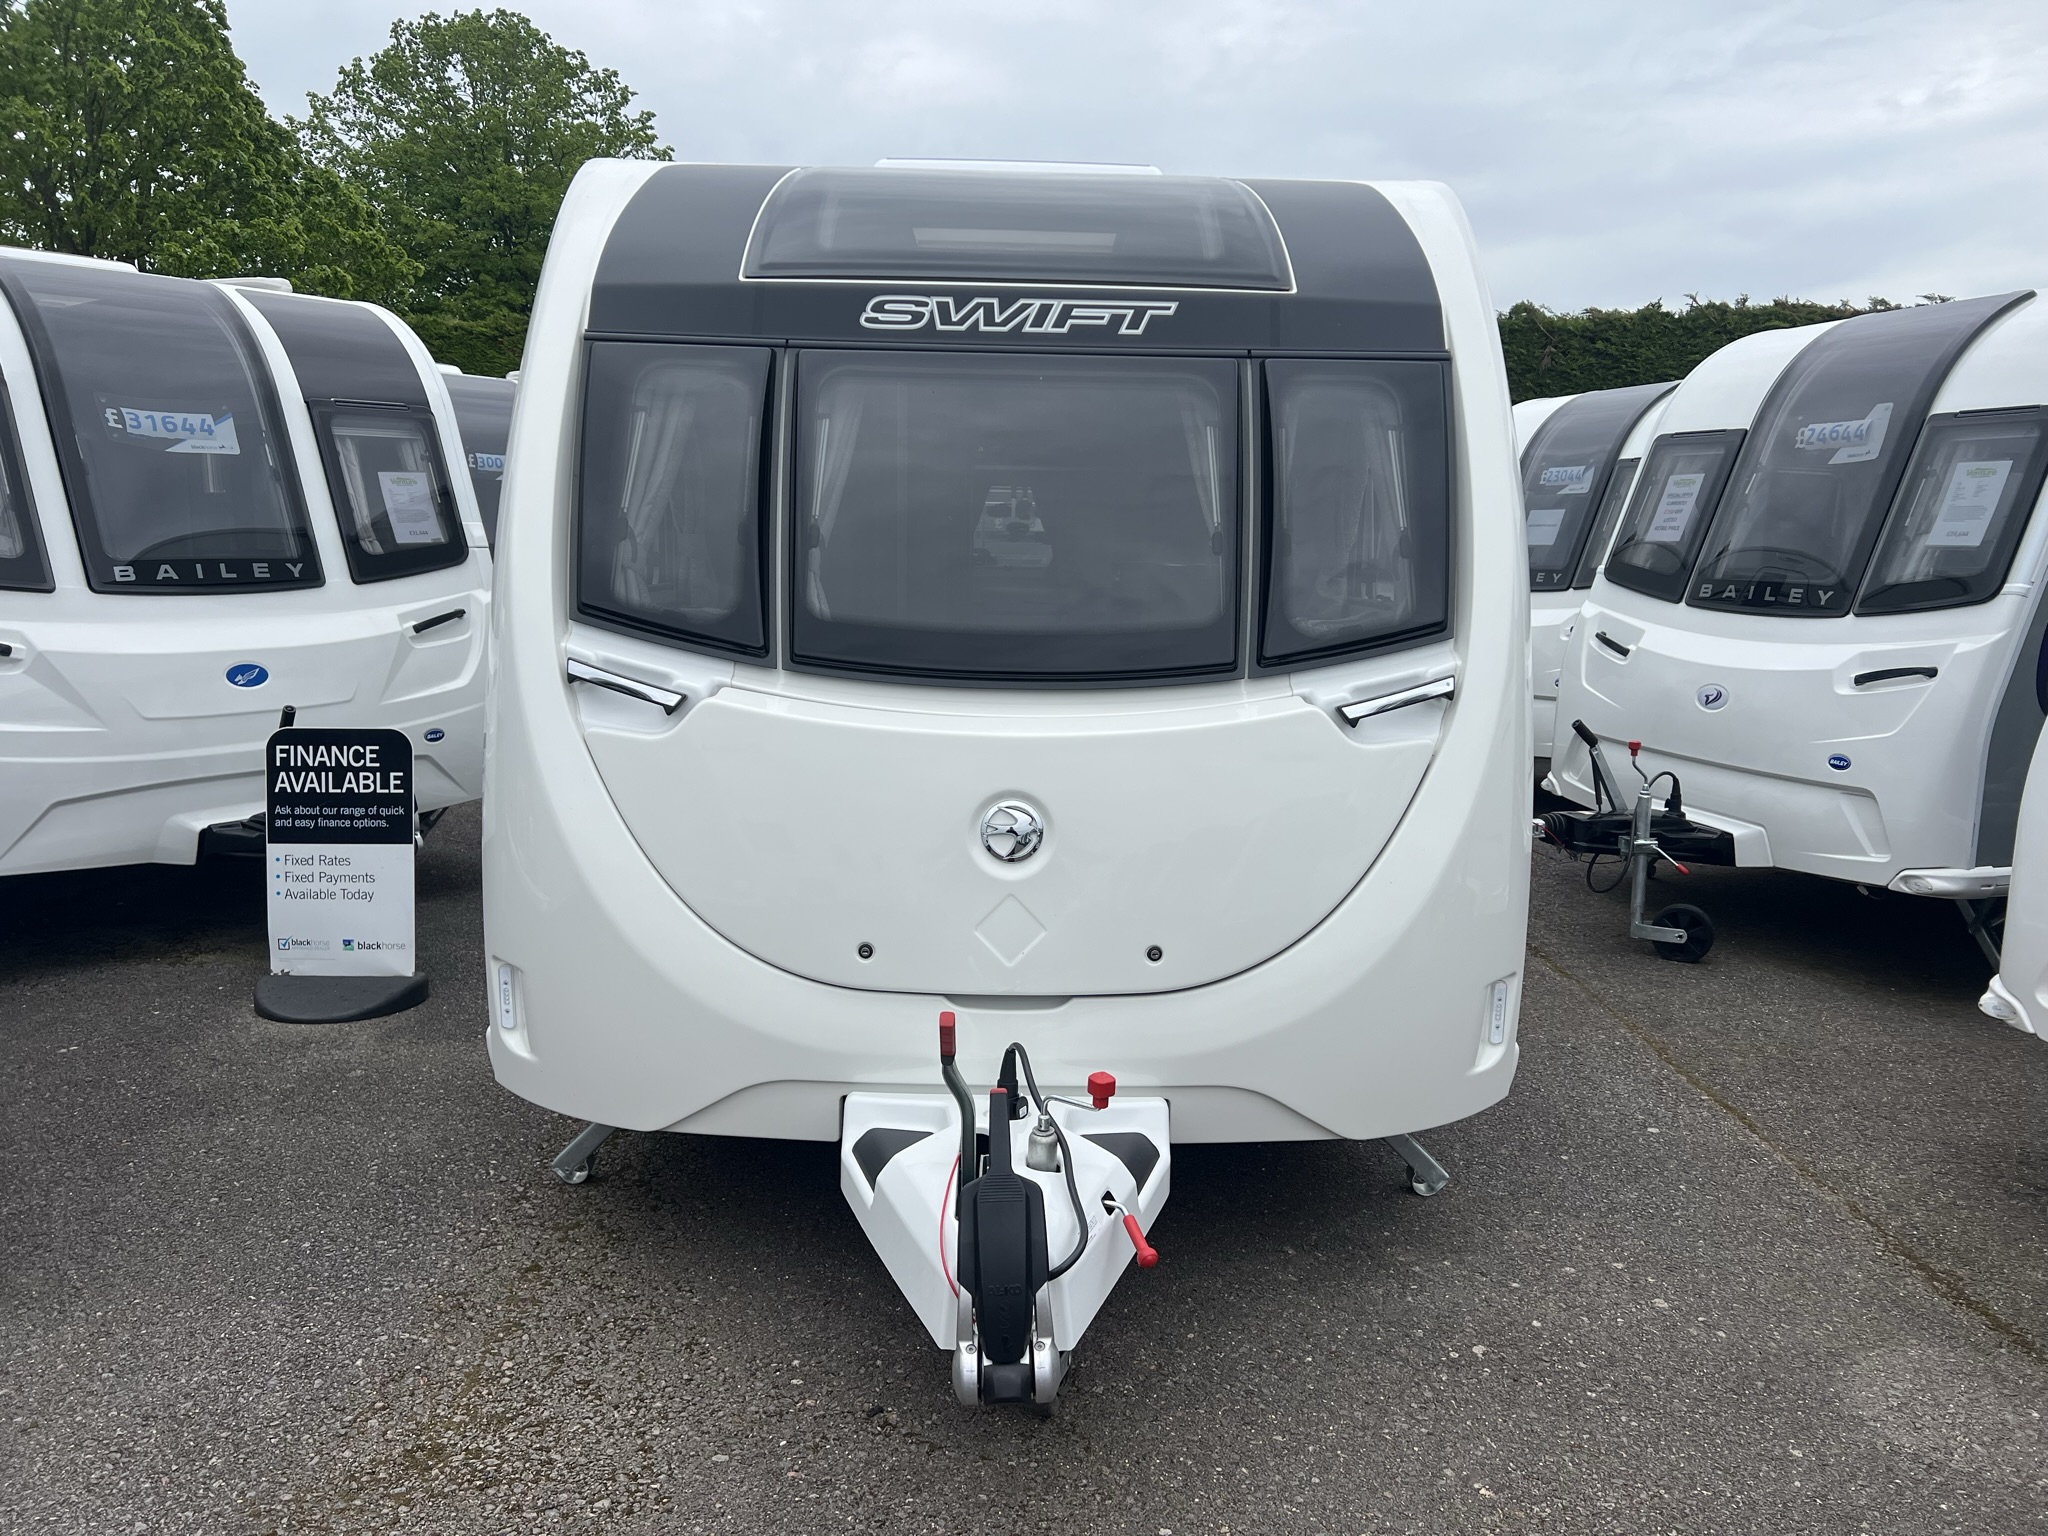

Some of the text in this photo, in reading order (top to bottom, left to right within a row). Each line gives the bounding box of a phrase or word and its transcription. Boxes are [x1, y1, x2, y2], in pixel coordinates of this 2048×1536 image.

[859, 295, 1179, 335] SWIFT
[104, 407, 215, 436] £31644
[1795, 423, 1865, 448] £24644
[468, 453, 503, 469] £300
[1539, 469, 1582, 484] £23044
[113, 563, 304, 582] BAILEY
[1699, 584, 1834, 606] BAILEY
[275, 745, 380, 767] FINANCE
[274, 771, 405, 794] AVAILABLE
[274, 805, 405, 817] Ask about our range of quick
[274, 818, 389, 829] and easy finance options.
[284, 854, 351, 866] Fixed Rates
[284, 871, 376, 886] Fixed Payments
[284, 888, 375, 903] Available Today
[291, 938, 330, 947] blackhorse
[357, 941, 406, 951] blackhorse
